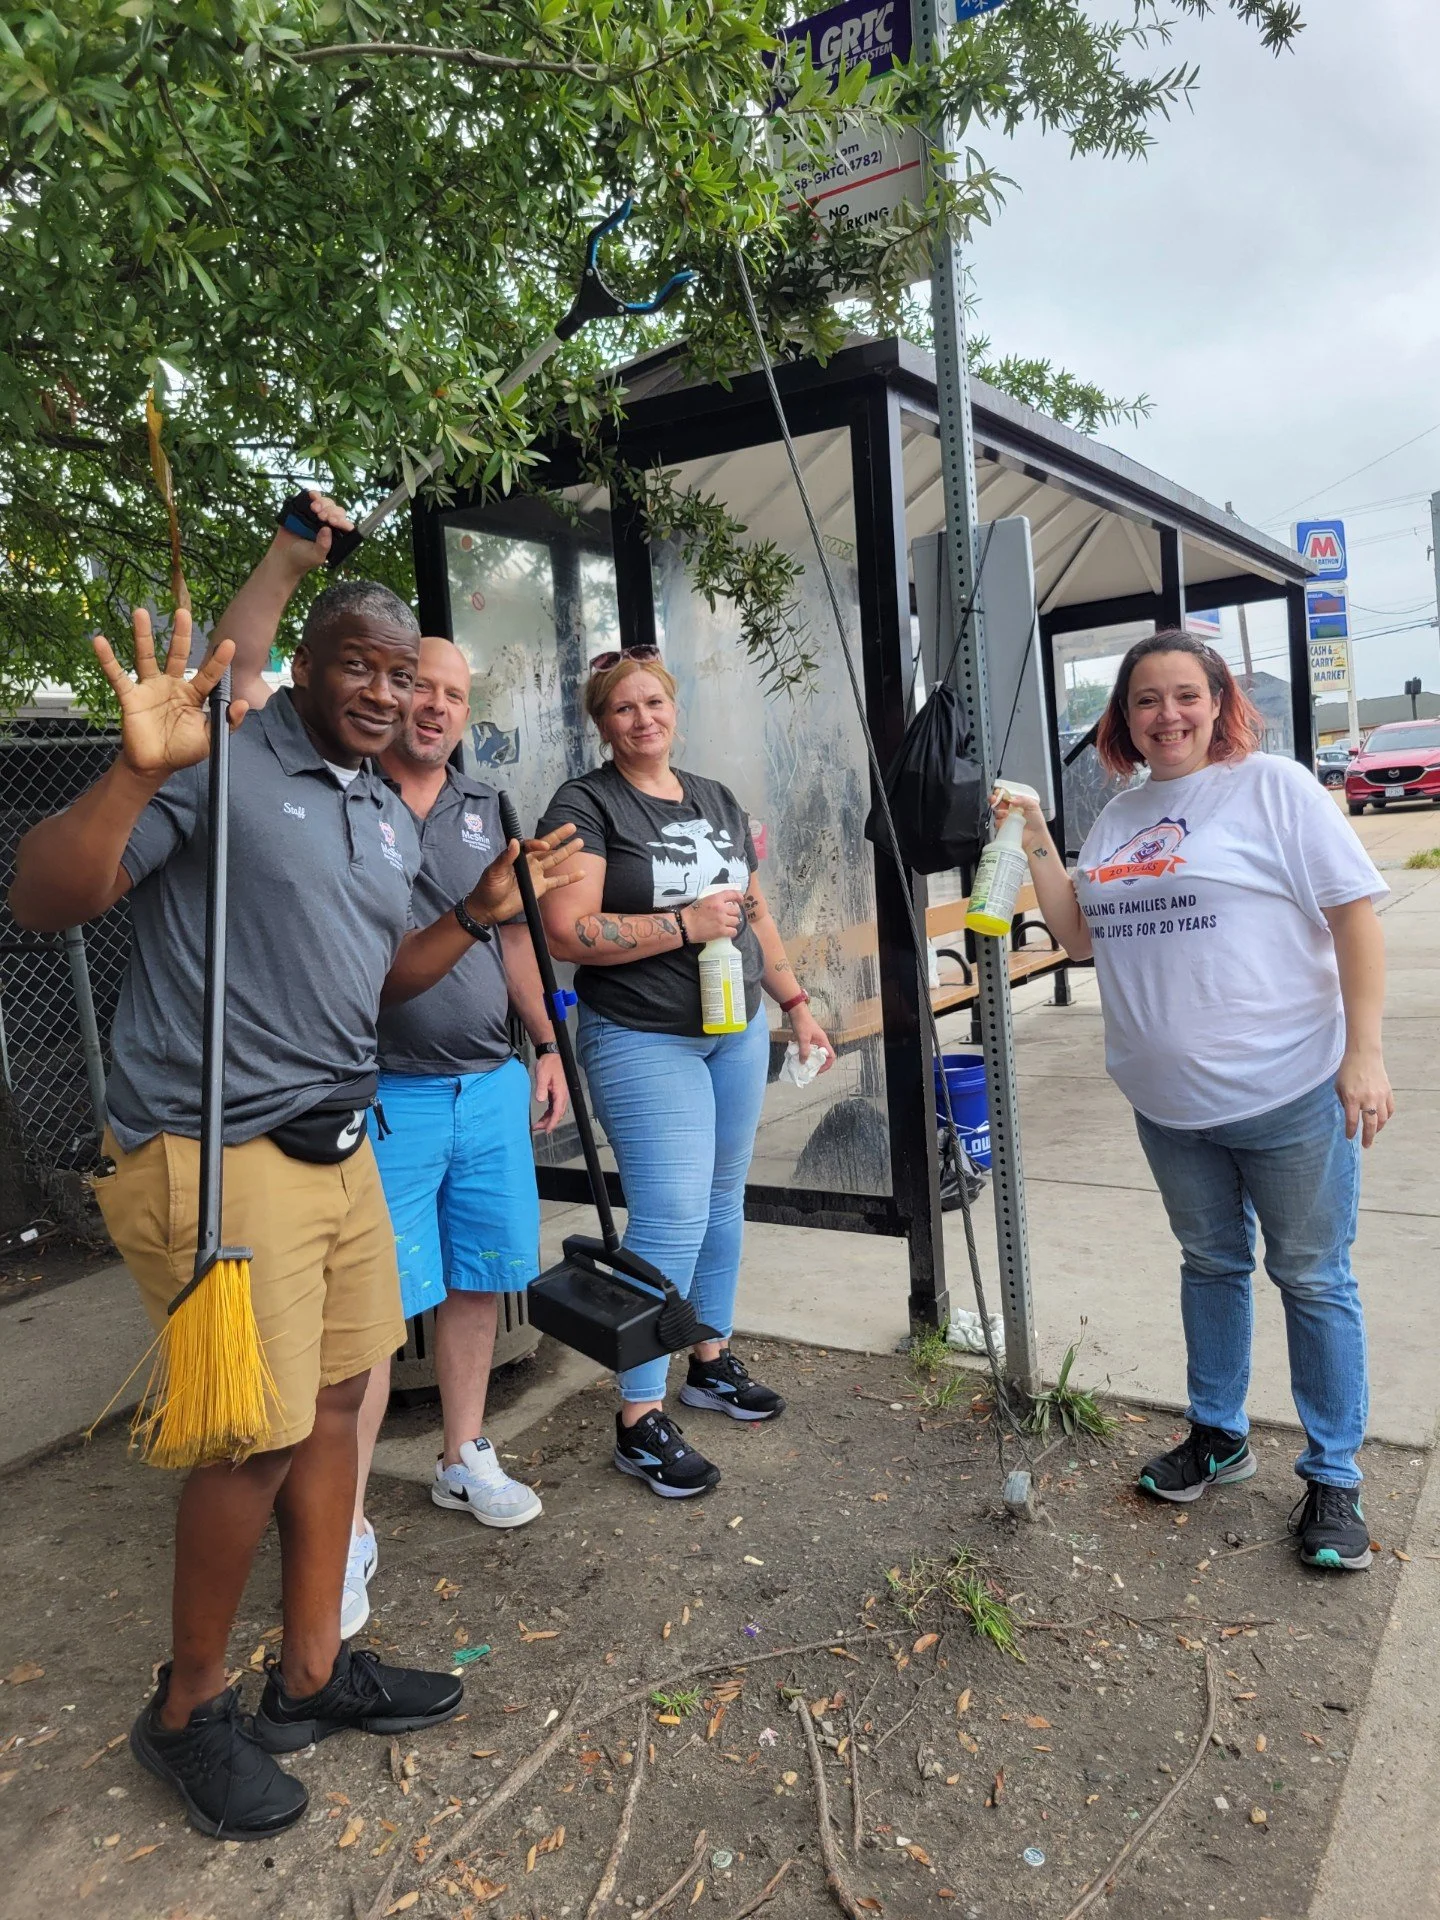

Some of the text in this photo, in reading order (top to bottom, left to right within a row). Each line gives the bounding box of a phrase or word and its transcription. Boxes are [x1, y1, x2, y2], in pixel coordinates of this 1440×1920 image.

[820, 2, 895, 63] GRTC
[860, 42, 893, 61] SYSTEM
[828, 204, 850, 220] NO
[830, 207, 889, 232] RKING
[1310, 645, 1327, 656] CASH
[1311, 656, 1334, 668] CARRY
[1313, 670, 1346, 682] MARKET
[283, 802, 307, 820] Staff
[461, 829, 491, 845] McShin
[1109, 862, 1159, 877] 20 YEARS
[1119, 897, 1167, 915] FAMILIES
[1171, 894, 1197, 909] AND
[1107, 924, 1133, 938] LIVES
[1136, 922, 1156, 936] FOR
[1160, 920, 1174, 934] 20
[1177, 914, 1217, 932] YEARS
